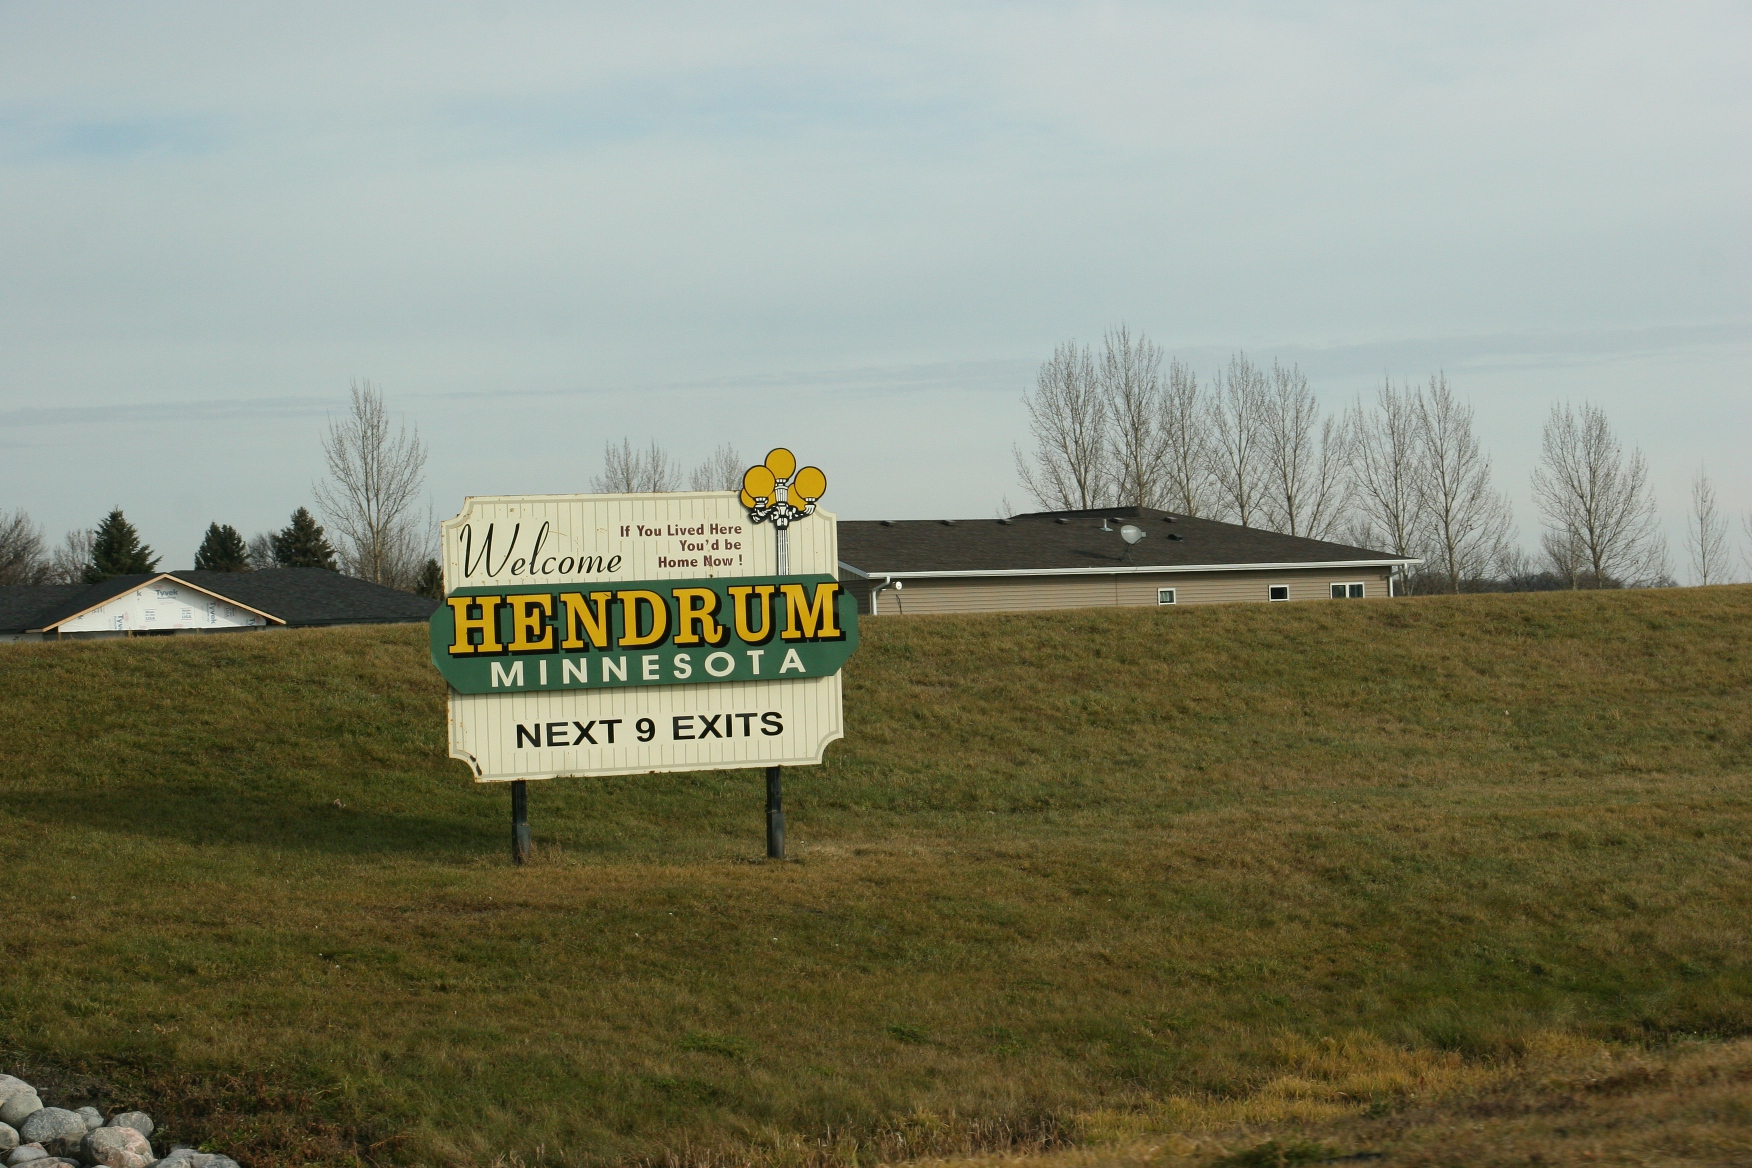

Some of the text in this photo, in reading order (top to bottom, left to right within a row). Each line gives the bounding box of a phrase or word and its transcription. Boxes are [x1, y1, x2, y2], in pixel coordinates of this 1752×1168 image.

[620, 523, 742, 538] If You Lived Here
[459, 520, 622, 578] Welcome
[679, 538, 742, 551] You'd be
[658, 556, 698, 568] Home
[703, 554, 734, 567] Now
[155, 588, 179, 598] Tyvek
[447, 582, 844, 656] HENDRUM
[490, 648, 806, 688] MINNESOTA
[516, 711, 784, 748] NEXT 9 EXITS
